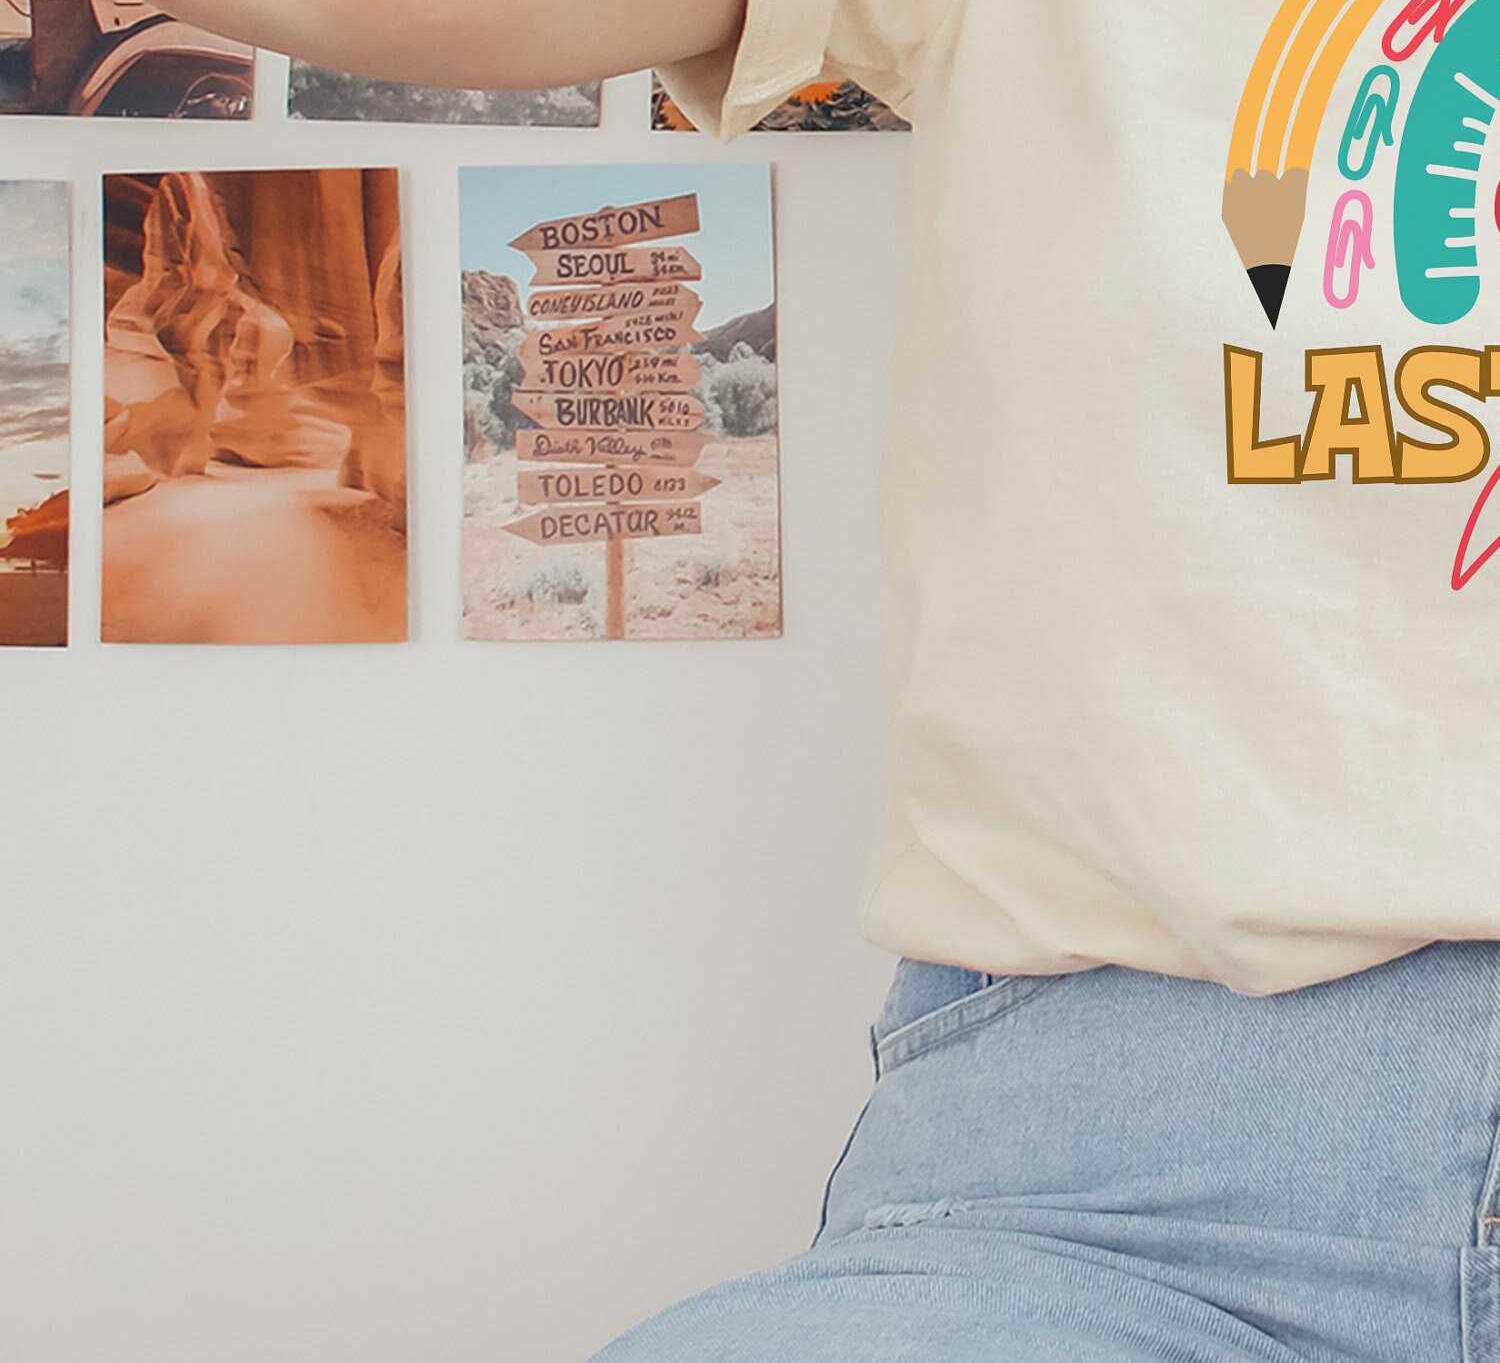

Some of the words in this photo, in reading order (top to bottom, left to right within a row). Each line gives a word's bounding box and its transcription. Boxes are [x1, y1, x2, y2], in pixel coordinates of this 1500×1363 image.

[540, 205, 664, 250] BOSTON
[556, 252, 635, 279] SEOUL
[541, 356, 625, 387] TOKYO
[555, 397, 655, 428] BURBANK
[537, 472, 643, 497] TOLEDO
